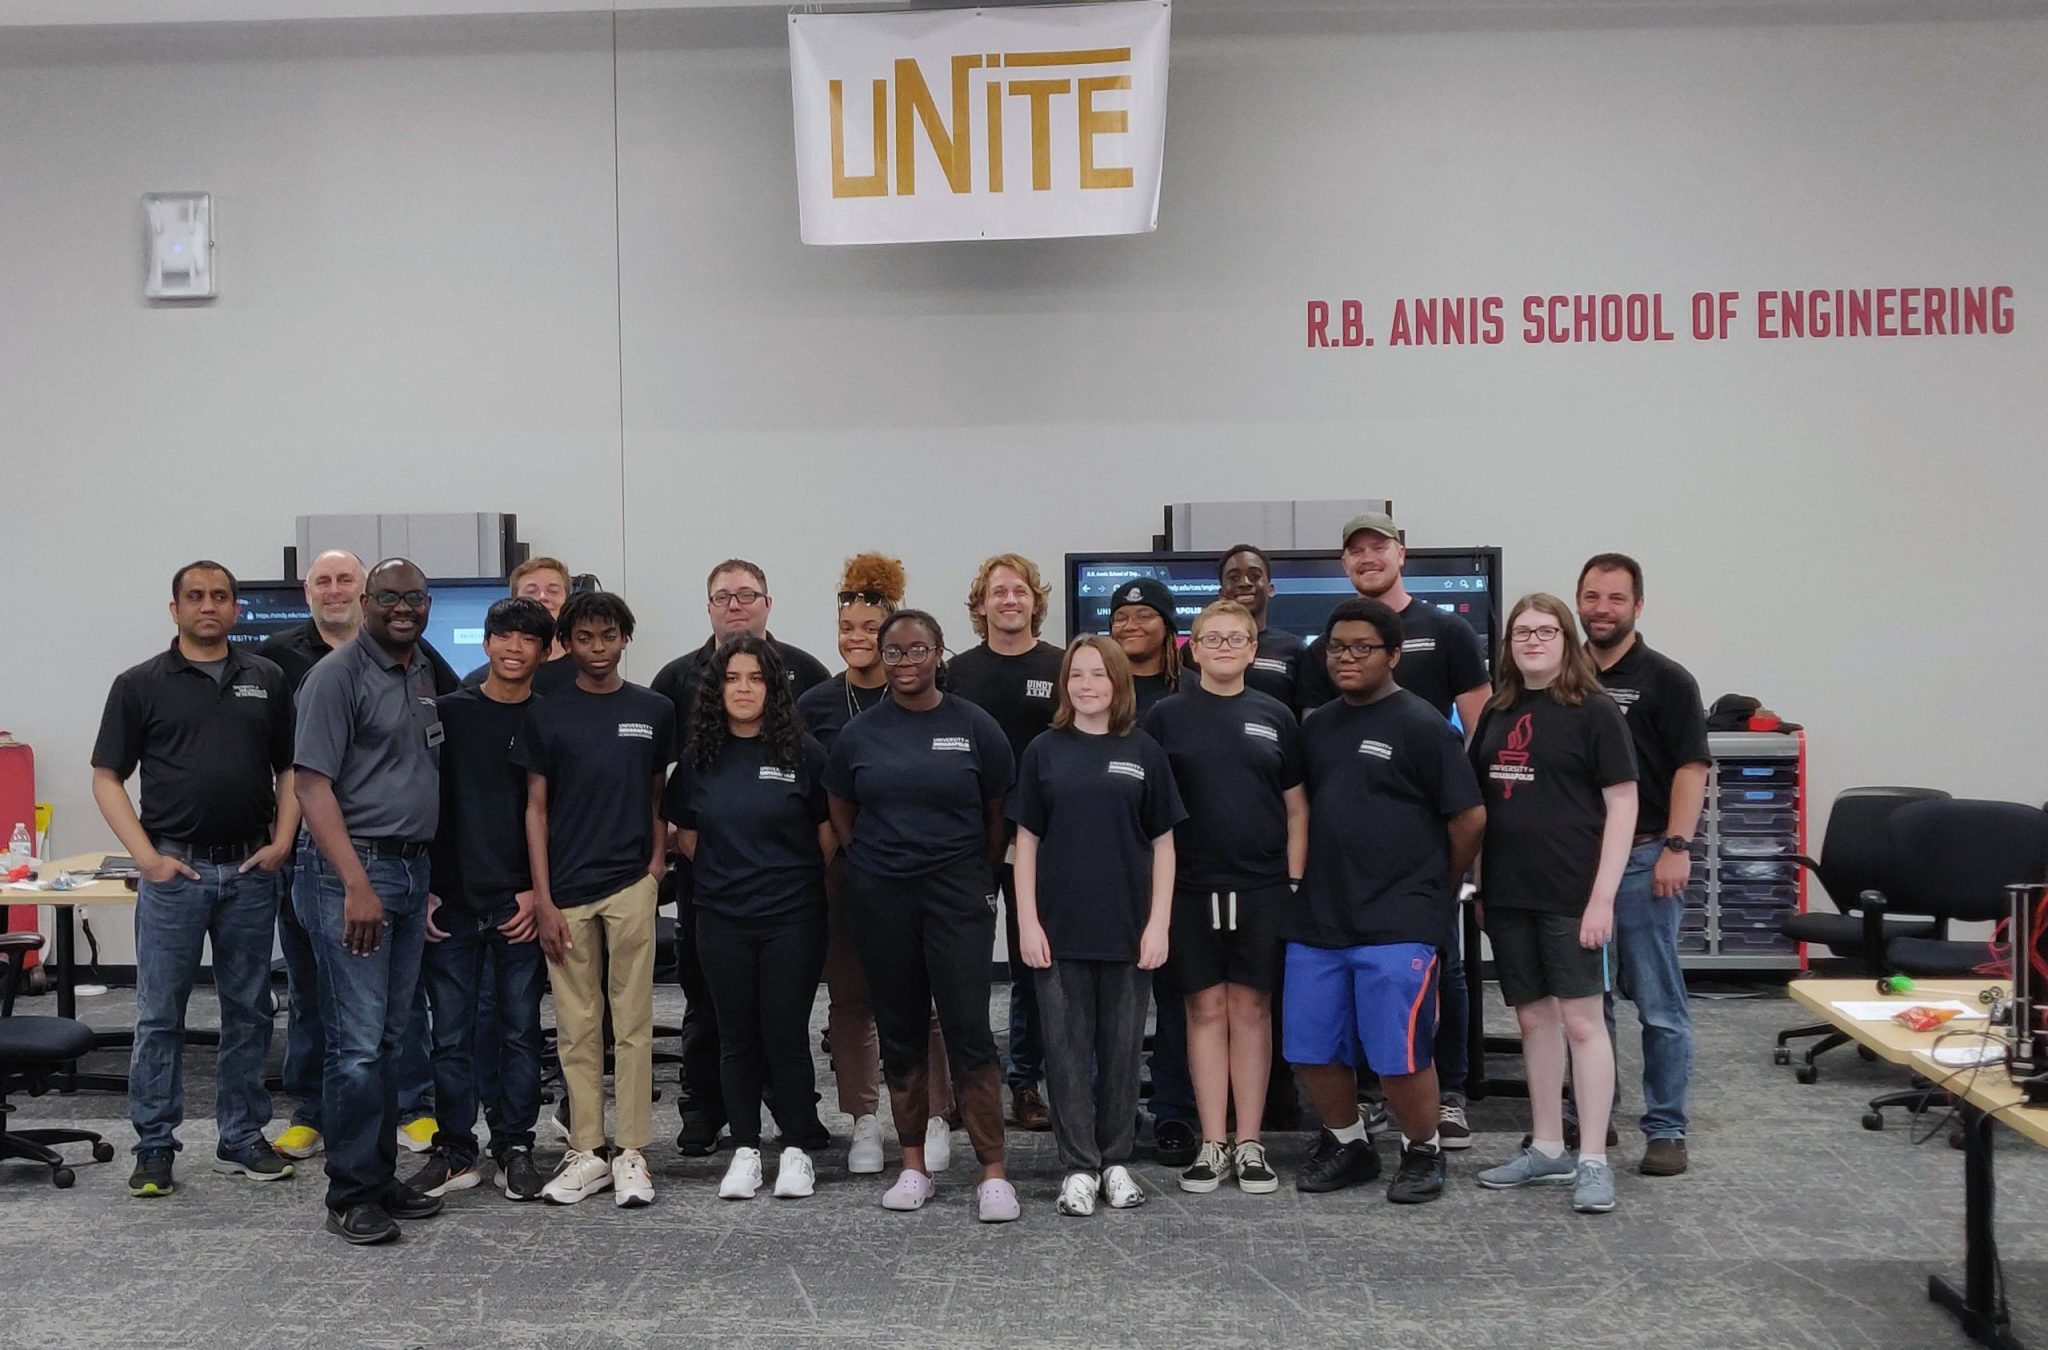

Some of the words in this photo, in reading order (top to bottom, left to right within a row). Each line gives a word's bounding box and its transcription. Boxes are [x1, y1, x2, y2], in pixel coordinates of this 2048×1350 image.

[1307, 300, 1374, 347] R.B.
[1389, 297, 1504, 346] ANNIS
[1523, 293, 1674, 343] SCHOOL
[1692, 291, 1739, 340] OF
[1758, 286, 2014, 338] ENGINEERING
